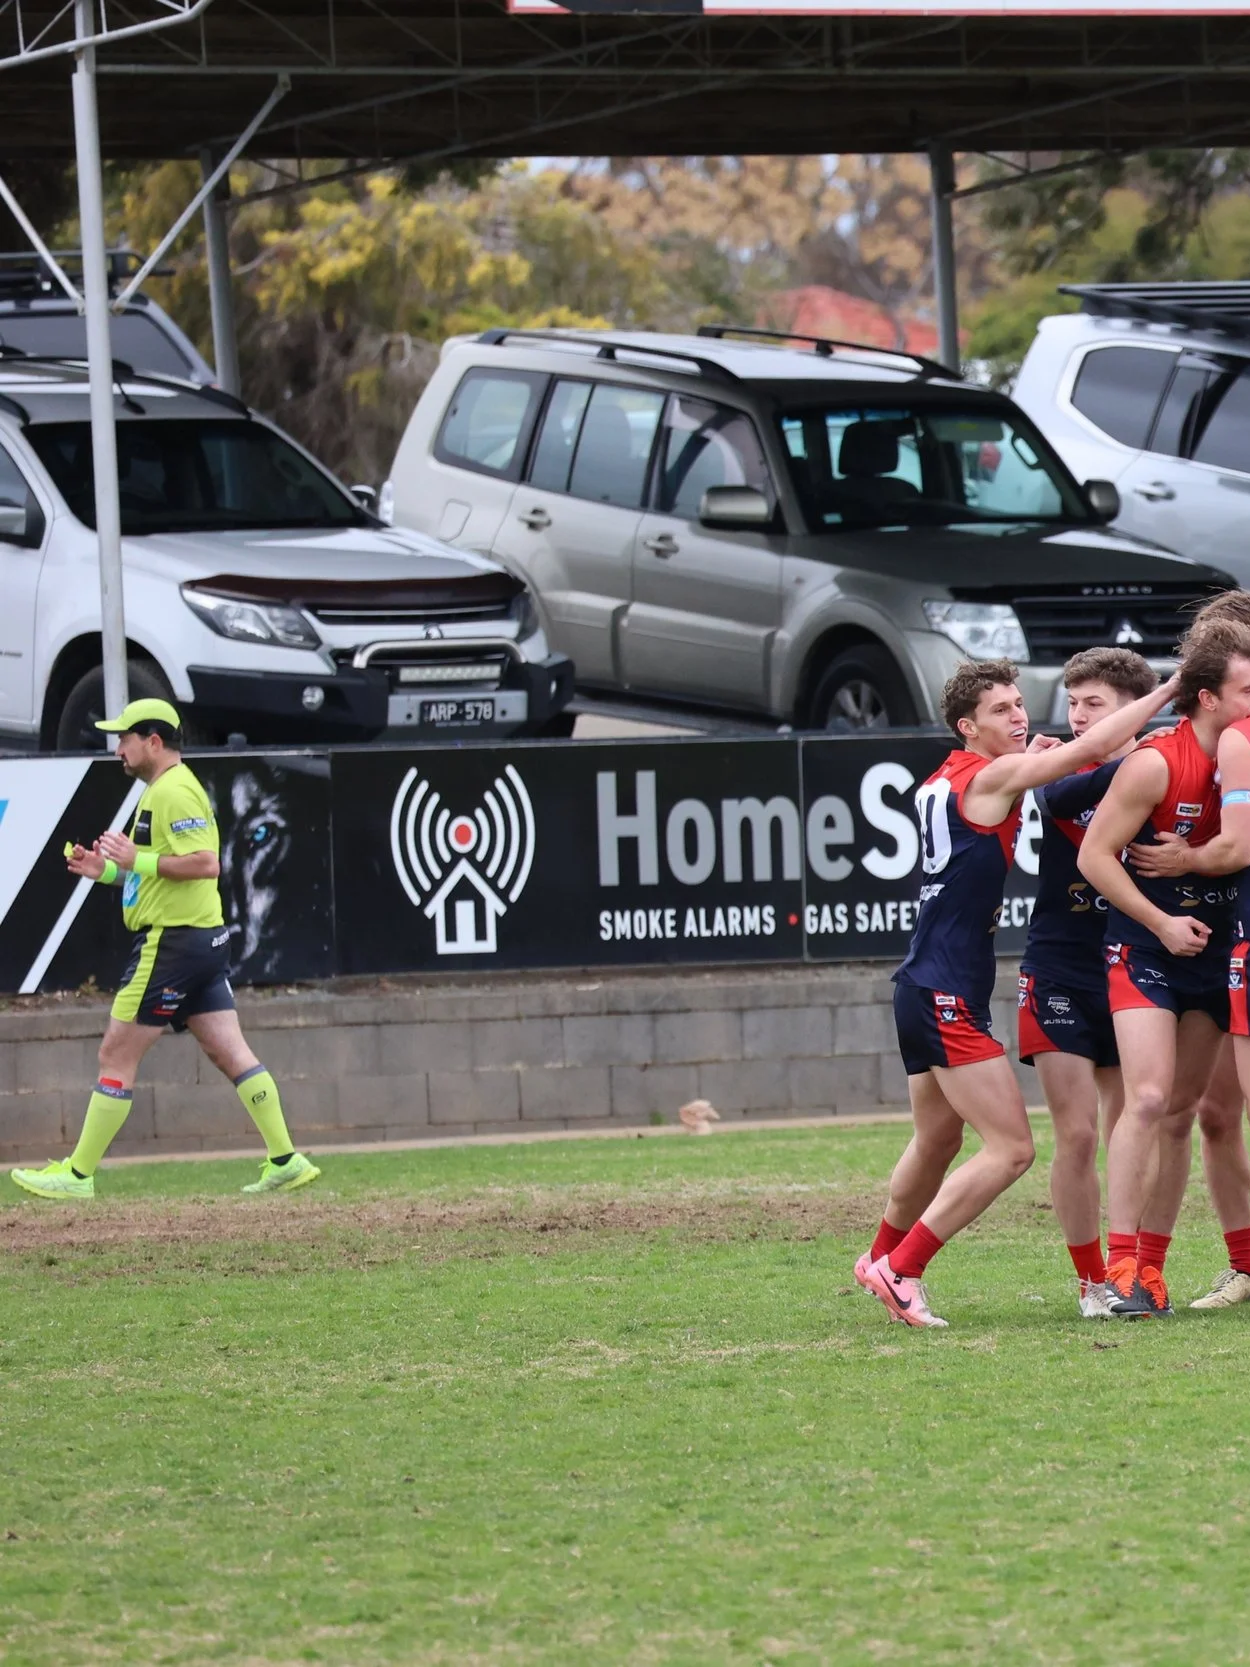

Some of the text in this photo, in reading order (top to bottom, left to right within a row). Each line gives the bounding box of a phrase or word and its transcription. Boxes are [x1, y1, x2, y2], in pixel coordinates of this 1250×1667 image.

[599, 908, 678, 941] SMOKE
[683, 904, 777, 938] ALARMS
[804, 903, 848, 935] GAS
